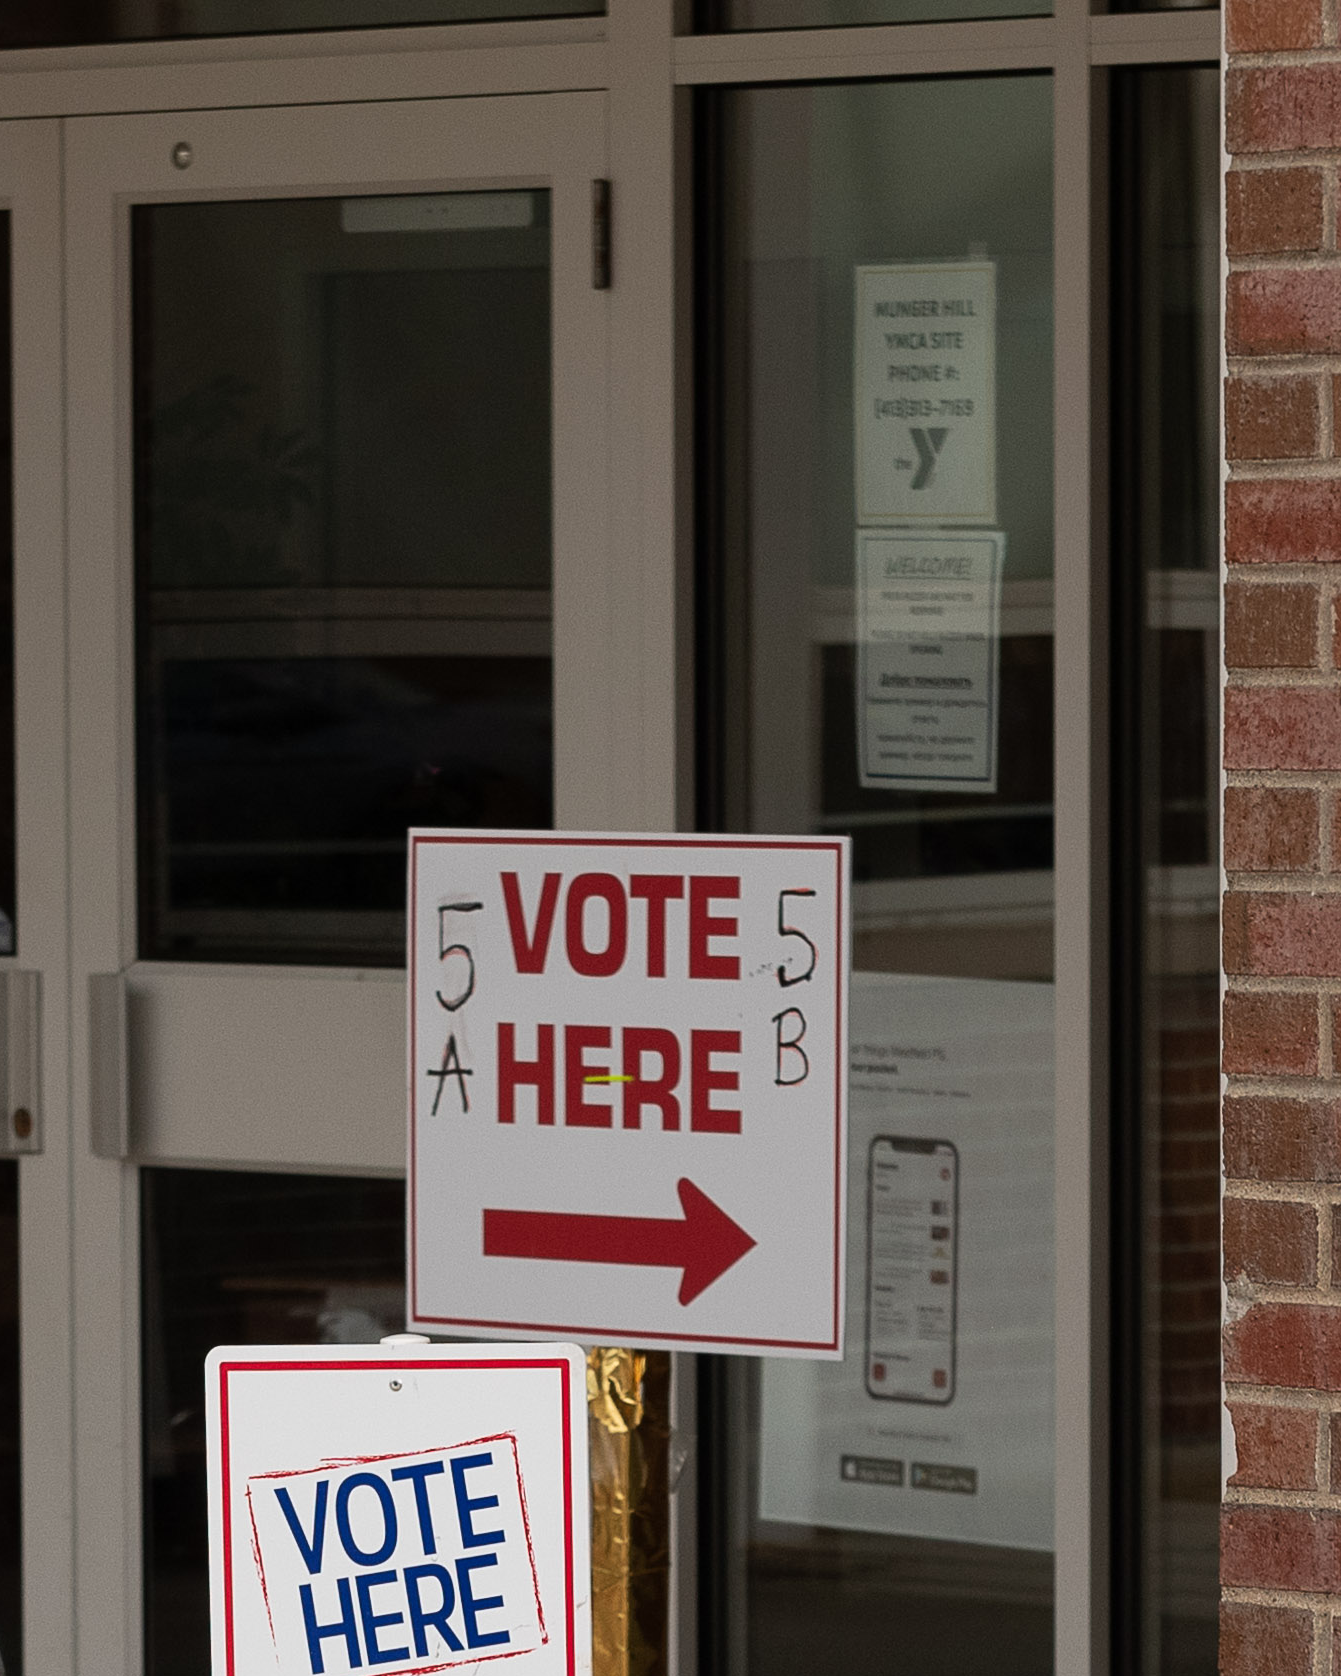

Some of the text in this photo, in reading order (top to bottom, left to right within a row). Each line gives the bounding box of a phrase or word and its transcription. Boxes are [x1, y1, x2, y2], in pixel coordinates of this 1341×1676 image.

[884, 331, 964, 350] YMCA SITE
[941, 298, 977, 317] HILL
[888, 365, 941, 382] PHONE
[437, 902, 483, 1011] 5
[500, 872, 741, 980] VOTE
[778, 888, 818, 987] 5
[427, 1033, 473, 1116] A
[497, 1023, 742, 1134] HERE
[772, 1007, 809, 1085] B
[274, 1452, 506, 1575] VOTE
[298, 1552, 510, 1674] HERE
